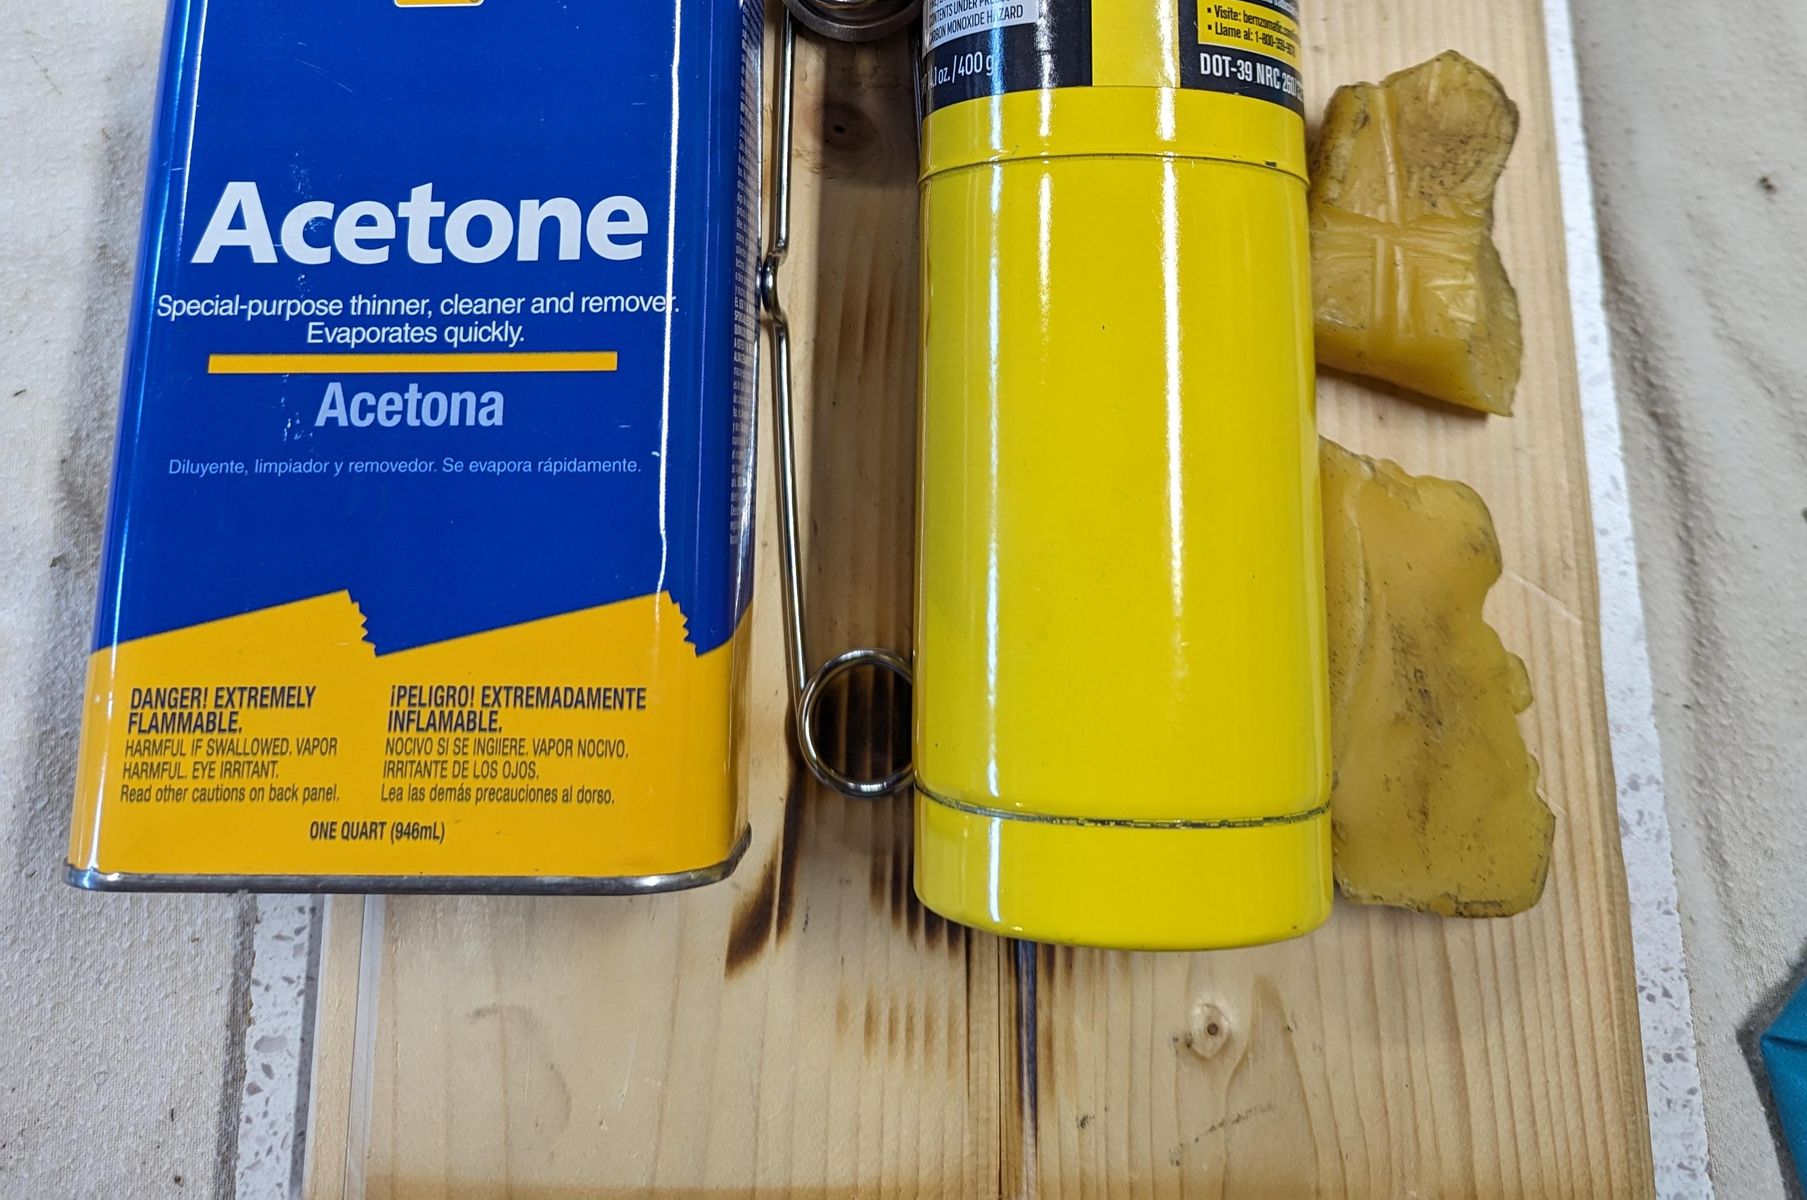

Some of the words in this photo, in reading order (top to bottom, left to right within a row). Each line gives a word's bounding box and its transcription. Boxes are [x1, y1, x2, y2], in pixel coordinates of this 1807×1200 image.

[946, 11, 985, 36] MONOXIDE
[986, 5, 1024, 24] HZARD
[1214, 4, 1242, 23] Visite:
[1215, 21, 1241, 39] Llame
[1243, 28, 1254, 42] al:
[1200, 52, 1253, 82] DOT-39
[1256, 62, 1281, 90] NRC
[190, 179, 650, 266] Acetone
[157, 294, 343, 322] Special-purpose
[350, 294, 433, 318] thinner,
[440, 293, 525, 316] cleaner
[530, 291, 574, 315] and
[306, 321, 437, 349] Evaporates
[444, 320, 525, 348] quickly.
[314, 381, 504, 428] Acetona
[168, 458, 249, 478] Diluyente,
[254, 457, 330, 477] limpiador
[333, 460, 344, 477] y
[348, 457, 437, 474] removedor.
[442, 457, 464, 473] Se
[469, 460, 532, 476] evapora
[537, 457, 642, 476] rápidamente.
[130, 686, 209, 710] DANGER!
[214, 685, 317, 709] EXTREMELY
[390, 684, 475, 709] ¡PELIGRO!
[480, 685, 648, 711] EXTREMADAMENTE
[127, 711, 243, 735] FLAMMABLE.
[387, 709, 503, 733] INFLAMABLE.
[125, 738, 187, 758] HARMFUL
[191, 738, 203, 757] IF
[206, 737, 293, 757] SWALLOWED.
[295, 736, 338, 756] VAPOR
[385, 736, 433, 756] NOCIVO
[437, 737, 449, 756] SI
[453, 737, 470, 756] SE
[532, 737, 573, 757] VAPOR
[577, 738, 629, 758] NOCIVO.
[122, 761, 188, 780] HARMFUL.
[192, 760, 216, 779] EYE
[219, 760, 280, 779] IRRITANT.
[383, 760, 448, 779] IRRITANTE
[452, 760, 469, 779] DE
[473, 760, 499, 779] LOS
[502, 760, 540, 780] OJOS.
[120, 784, 152, 803] Read
[155, 784, 188, 802] other
[192, 784, 246, 802] cautions
[249, 786, 265, 801] on
[269, 783, 299, 801] back
[302, 783, 340, 805] panel.
[380, 783, 403, 802] Lea
[407, 783, 426, 802] las
[429, 782, 472, 802] demás
[475, 784, 558, 806] precauciones
[561, 784, 572, 803] al
[576, 785, 615, 805] dorso.
[310, 820, 338, 840] ONE
[341, 820, 387, 841] QUART
[390, 821, 446, 844] (946mL)
